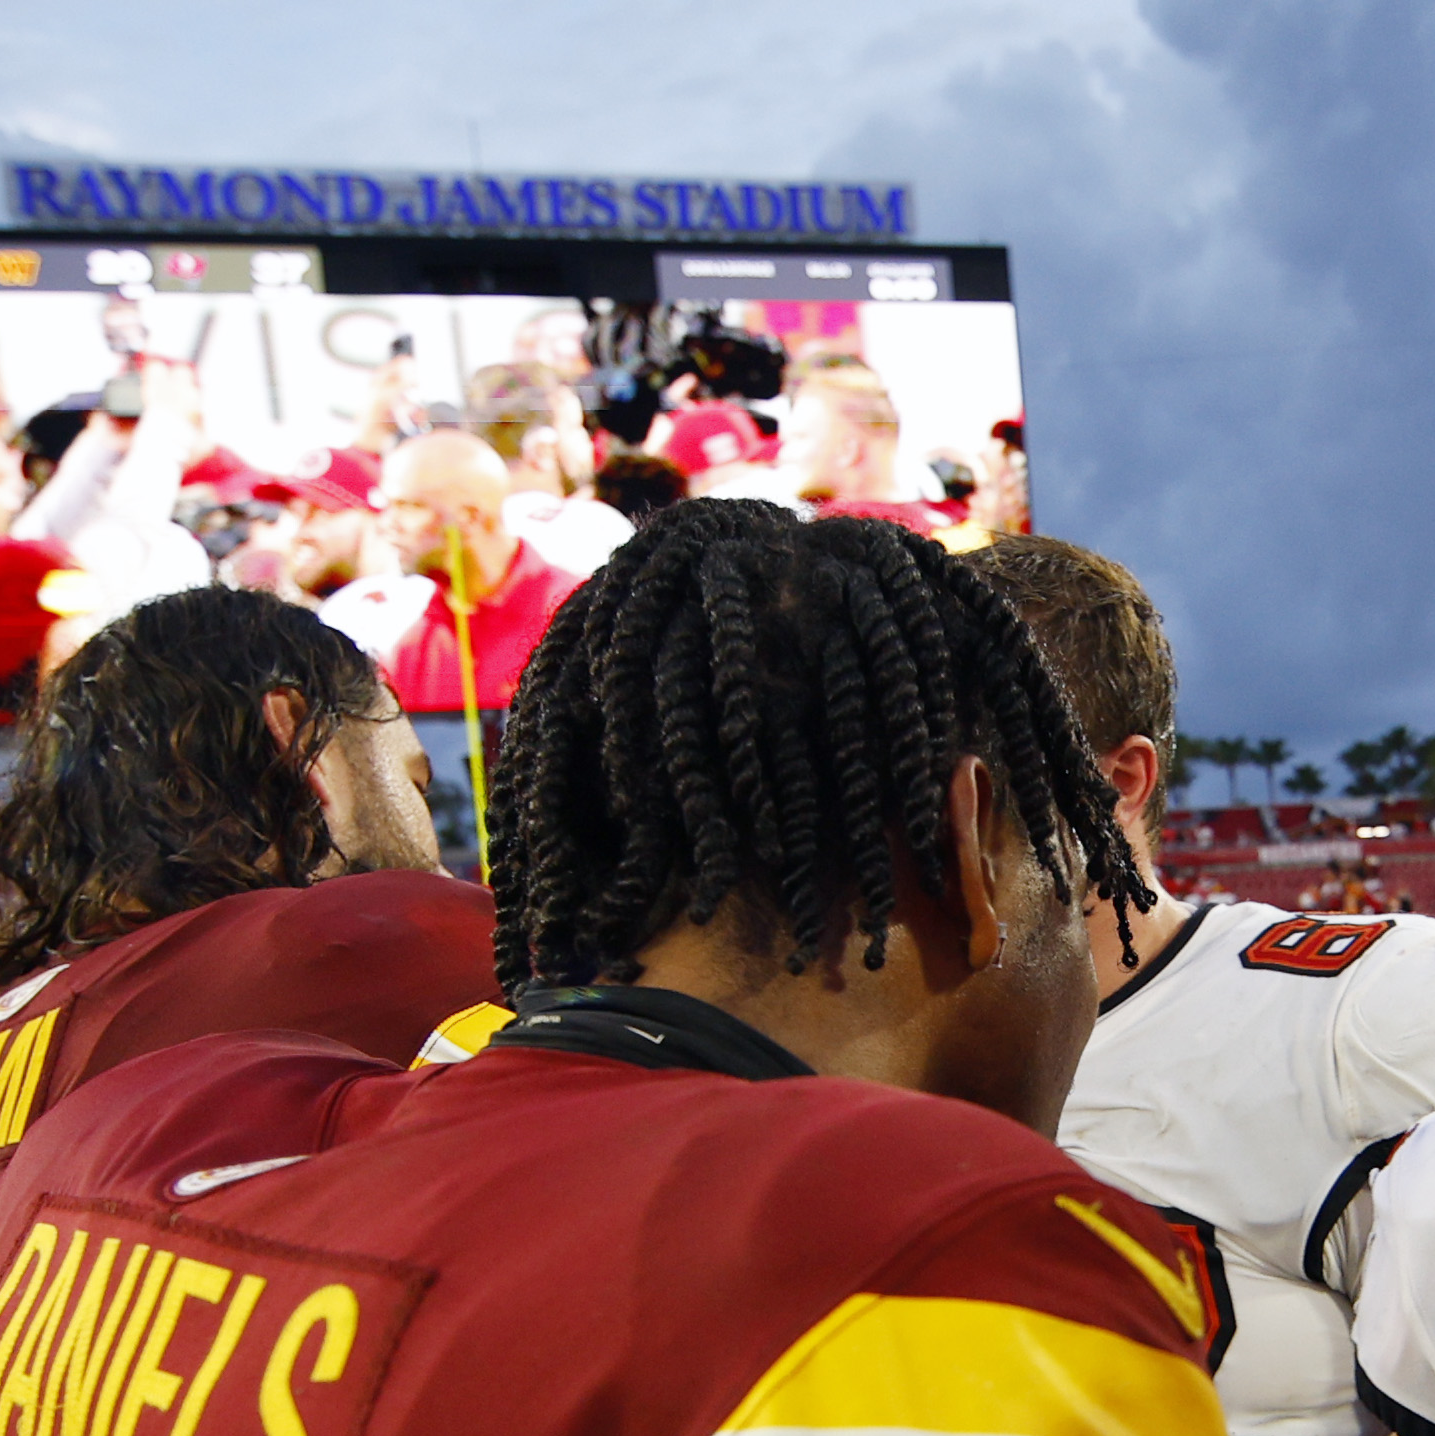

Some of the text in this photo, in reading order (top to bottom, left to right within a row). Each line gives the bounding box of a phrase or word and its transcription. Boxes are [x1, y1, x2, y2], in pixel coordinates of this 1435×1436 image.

[13, 161, 909, 236] RAYMOND JAMES STADIUM
